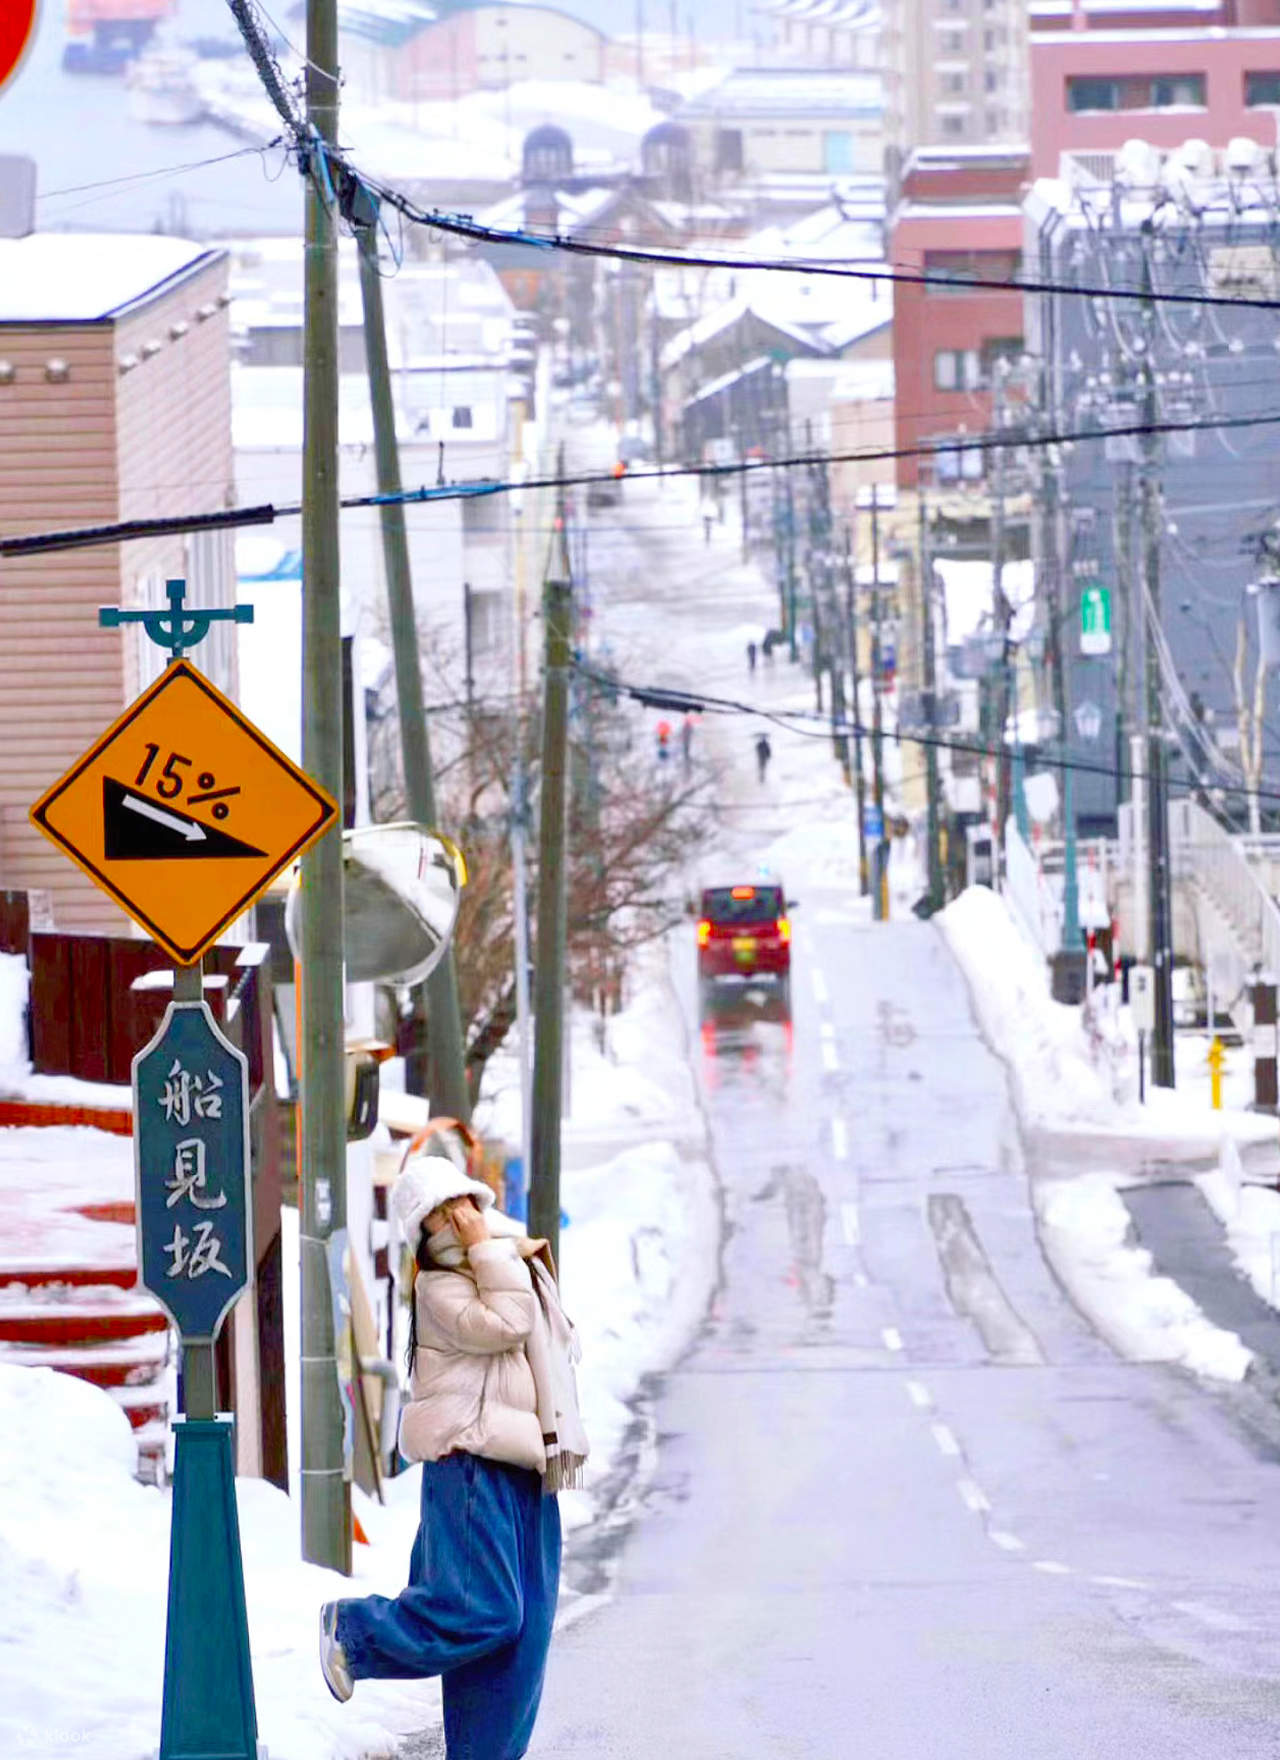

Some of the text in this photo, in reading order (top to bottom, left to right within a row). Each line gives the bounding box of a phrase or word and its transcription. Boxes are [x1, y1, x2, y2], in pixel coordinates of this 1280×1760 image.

[135, 743, 241, 820] 15%
[158, 1059, 232, 1279] 船見坂
